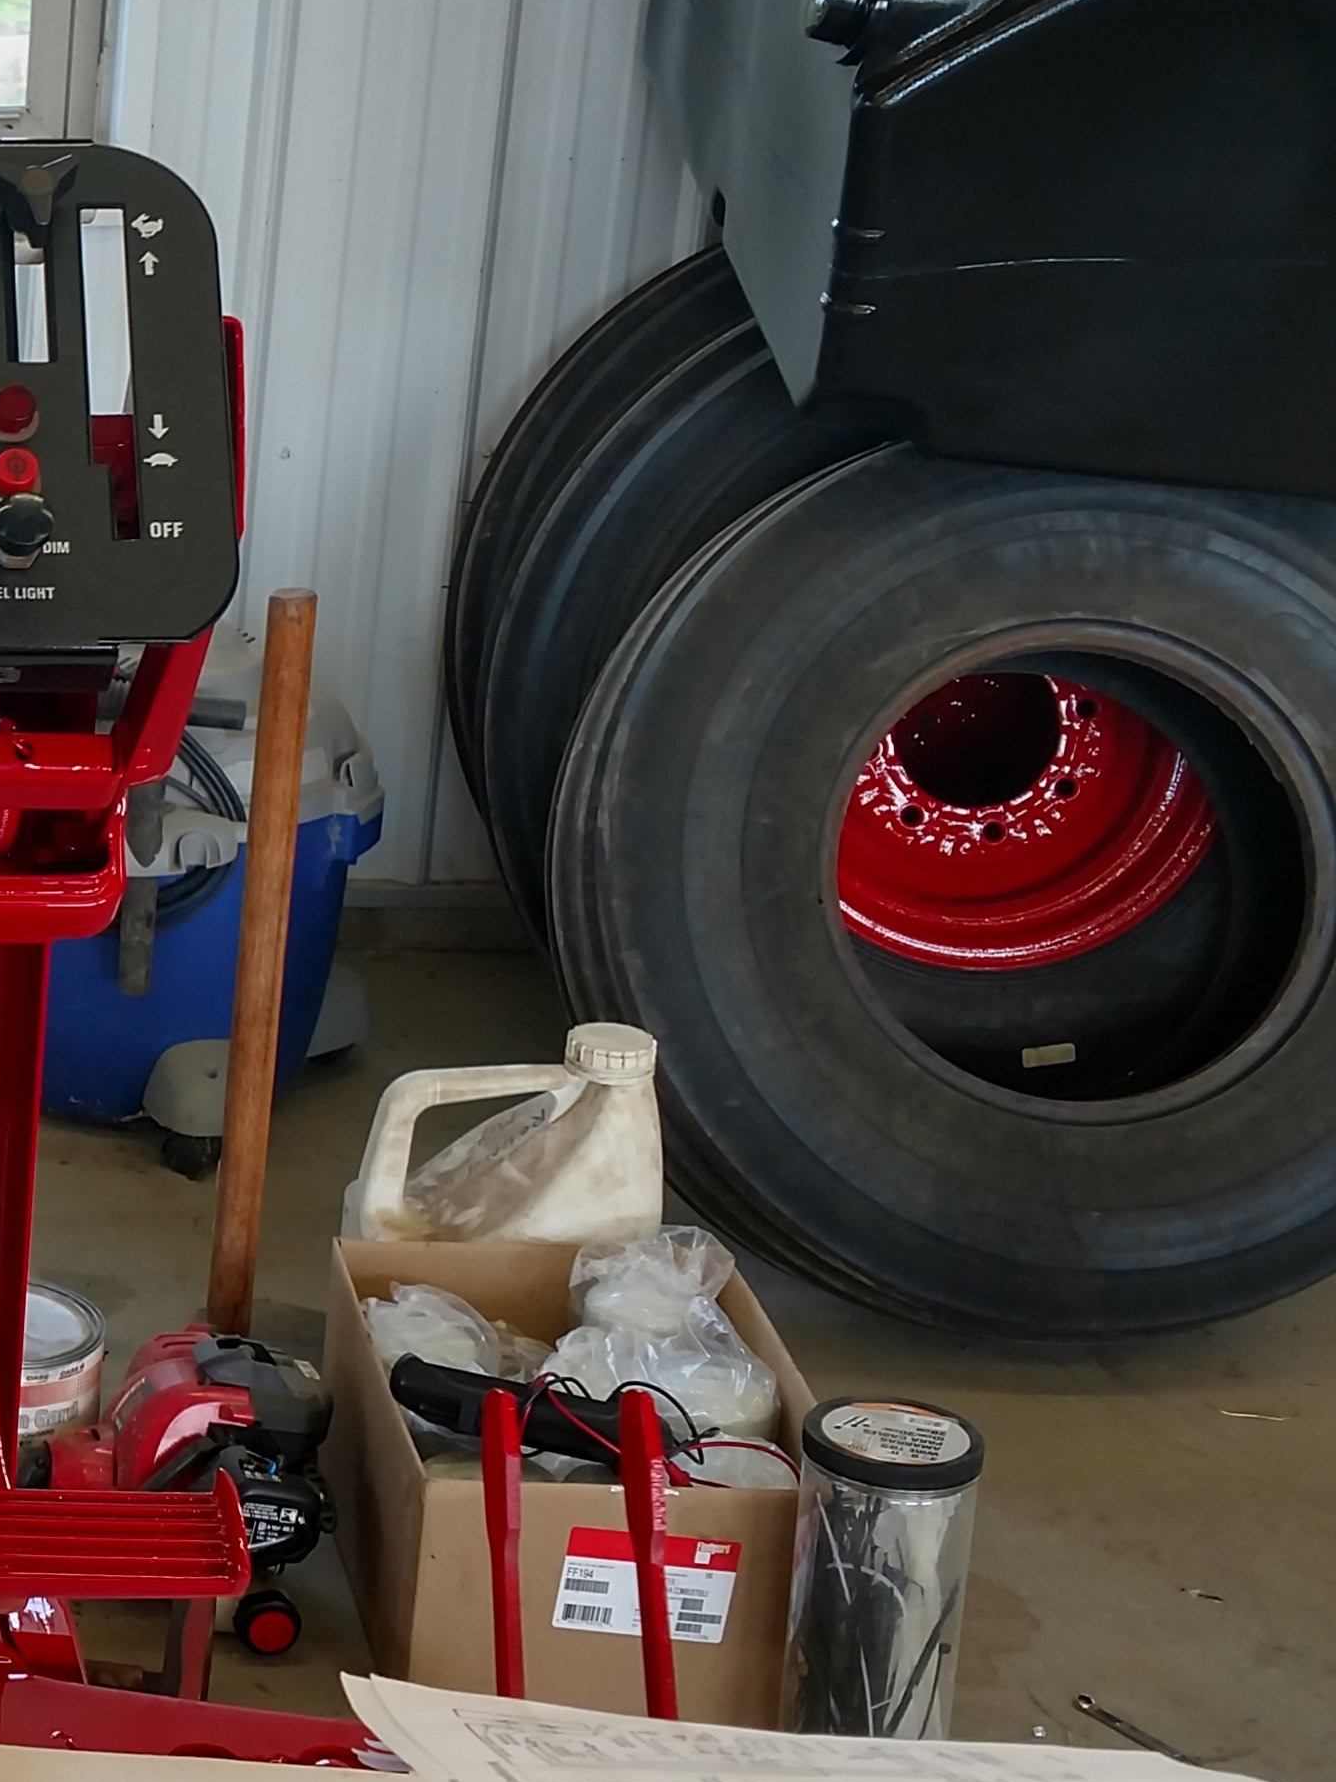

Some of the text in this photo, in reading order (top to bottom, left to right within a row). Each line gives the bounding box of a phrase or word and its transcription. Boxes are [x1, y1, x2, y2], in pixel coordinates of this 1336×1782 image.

[149, 521, 184, 539] OFF
[42, 541, 70, 554] DIM
[14, 586, 55, 600] LIGHT
[566, 1566, 595, 1579] FF194
